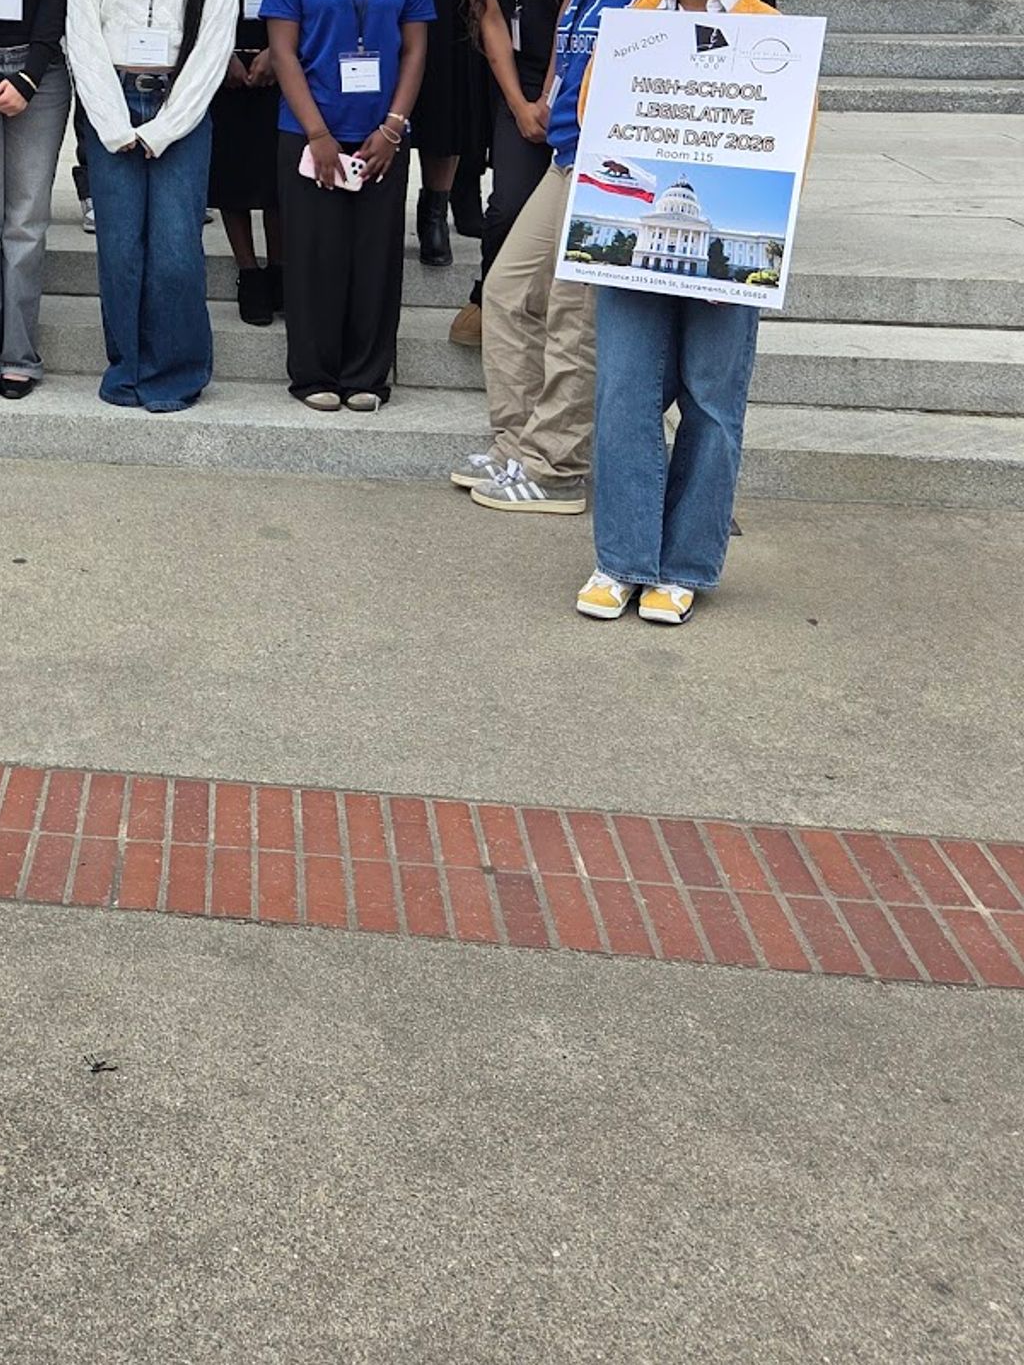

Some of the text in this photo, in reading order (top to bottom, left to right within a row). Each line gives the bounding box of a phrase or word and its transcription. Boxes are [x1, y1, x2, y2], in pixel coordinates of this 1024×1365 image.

[613, 31, 669, 58] April 20th
[631, 76, 768, 101] HIGH-SCHOOL
[635, 101, 755, 125] LEGISLATIVE
[607, 123, 775, 152] ACTION DAY 2026
[655, 148, 714, 162] Room 115
